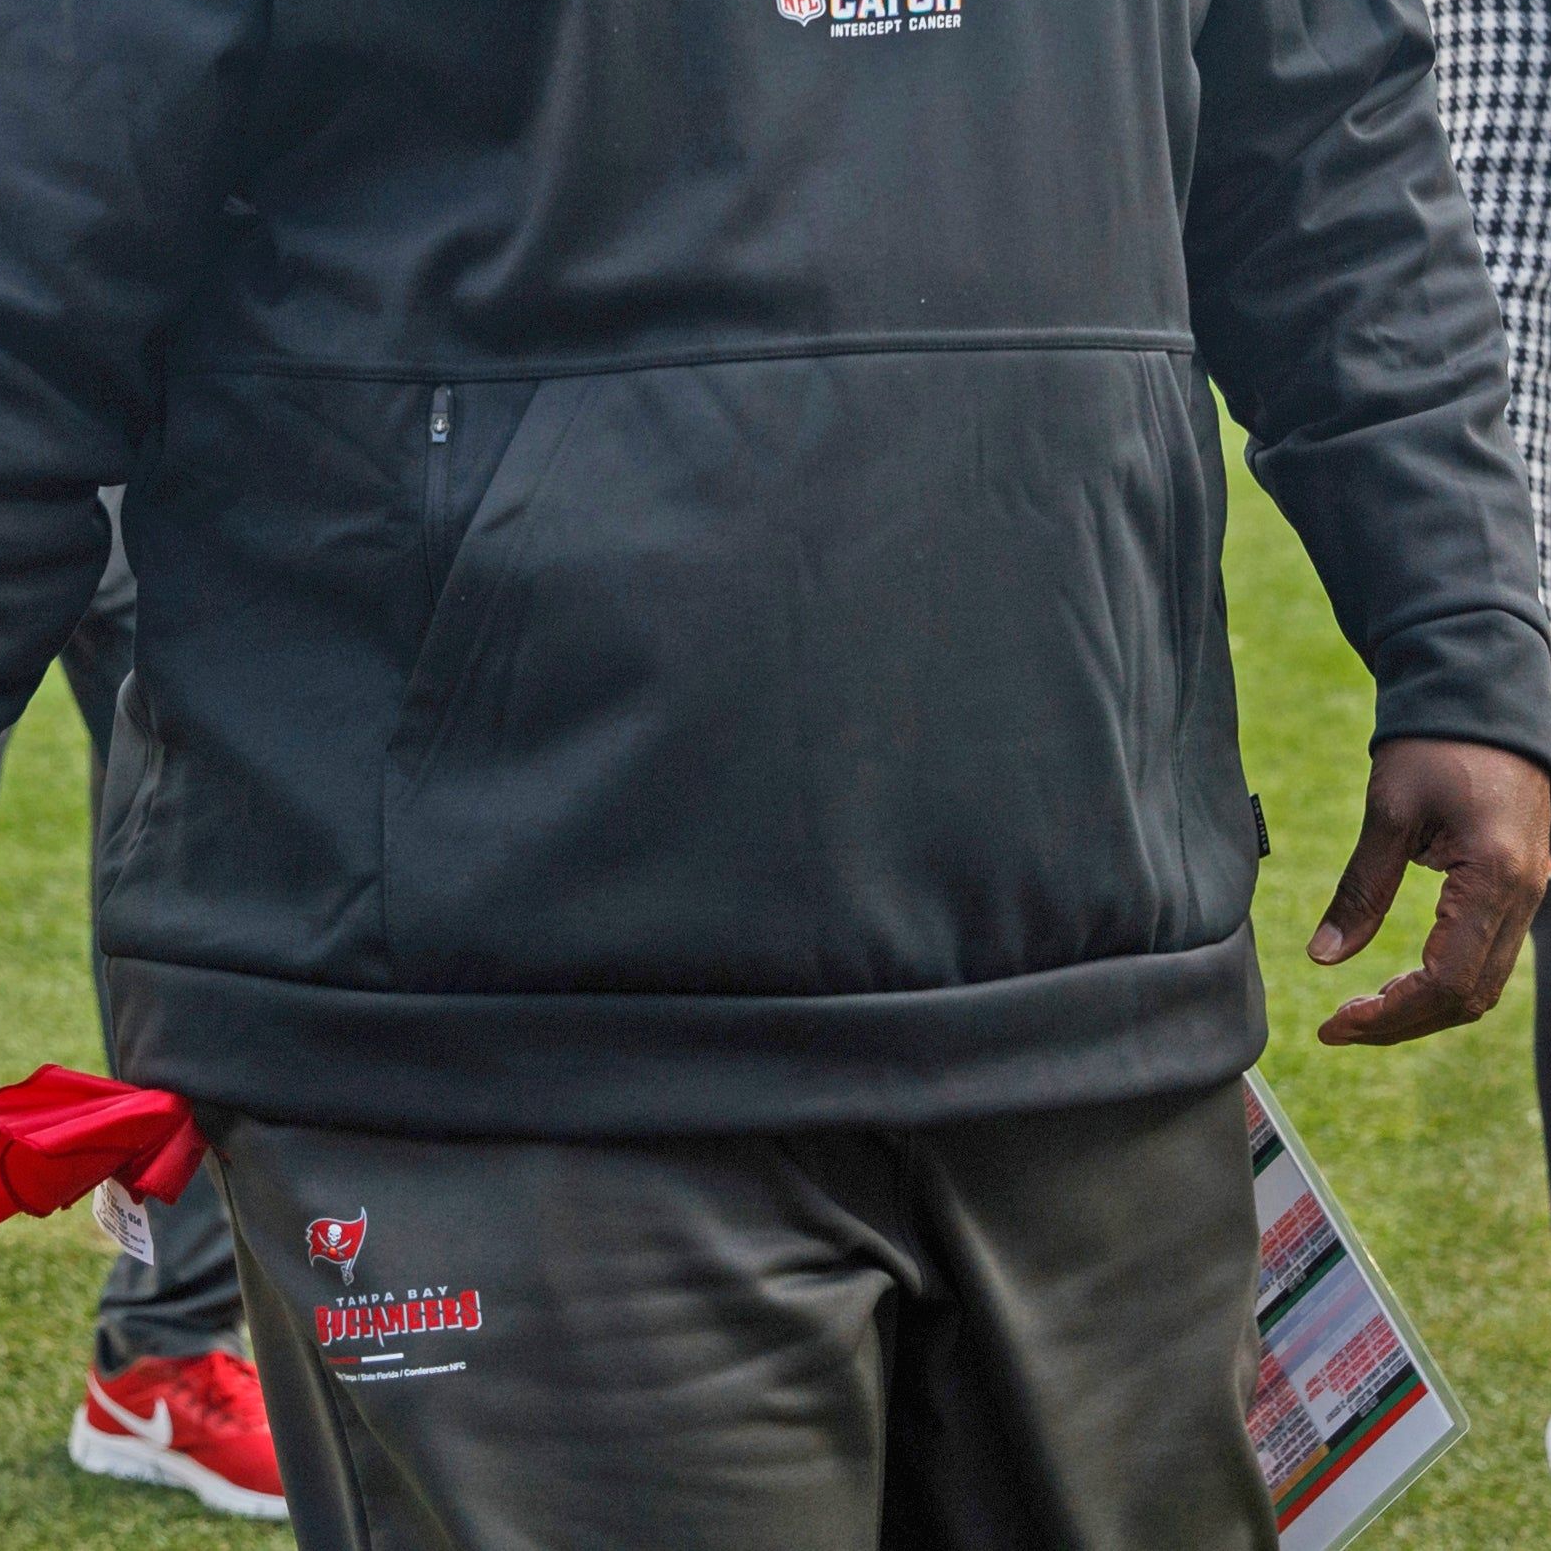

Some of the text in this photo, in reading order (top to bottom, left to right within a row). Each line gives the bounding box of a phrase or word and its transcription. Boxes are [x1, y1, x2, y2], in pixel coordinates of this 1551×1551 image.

[830, 14, 962, 38] INTERCEPT CANCER
[336, 1285, 449, 1308] TAMPA BAY
[314, 1288, 483, 1348] BUCCANEERS
[377, 1370, 400, 1381] Florida
[450, 1361, 467, 1372] NFC
